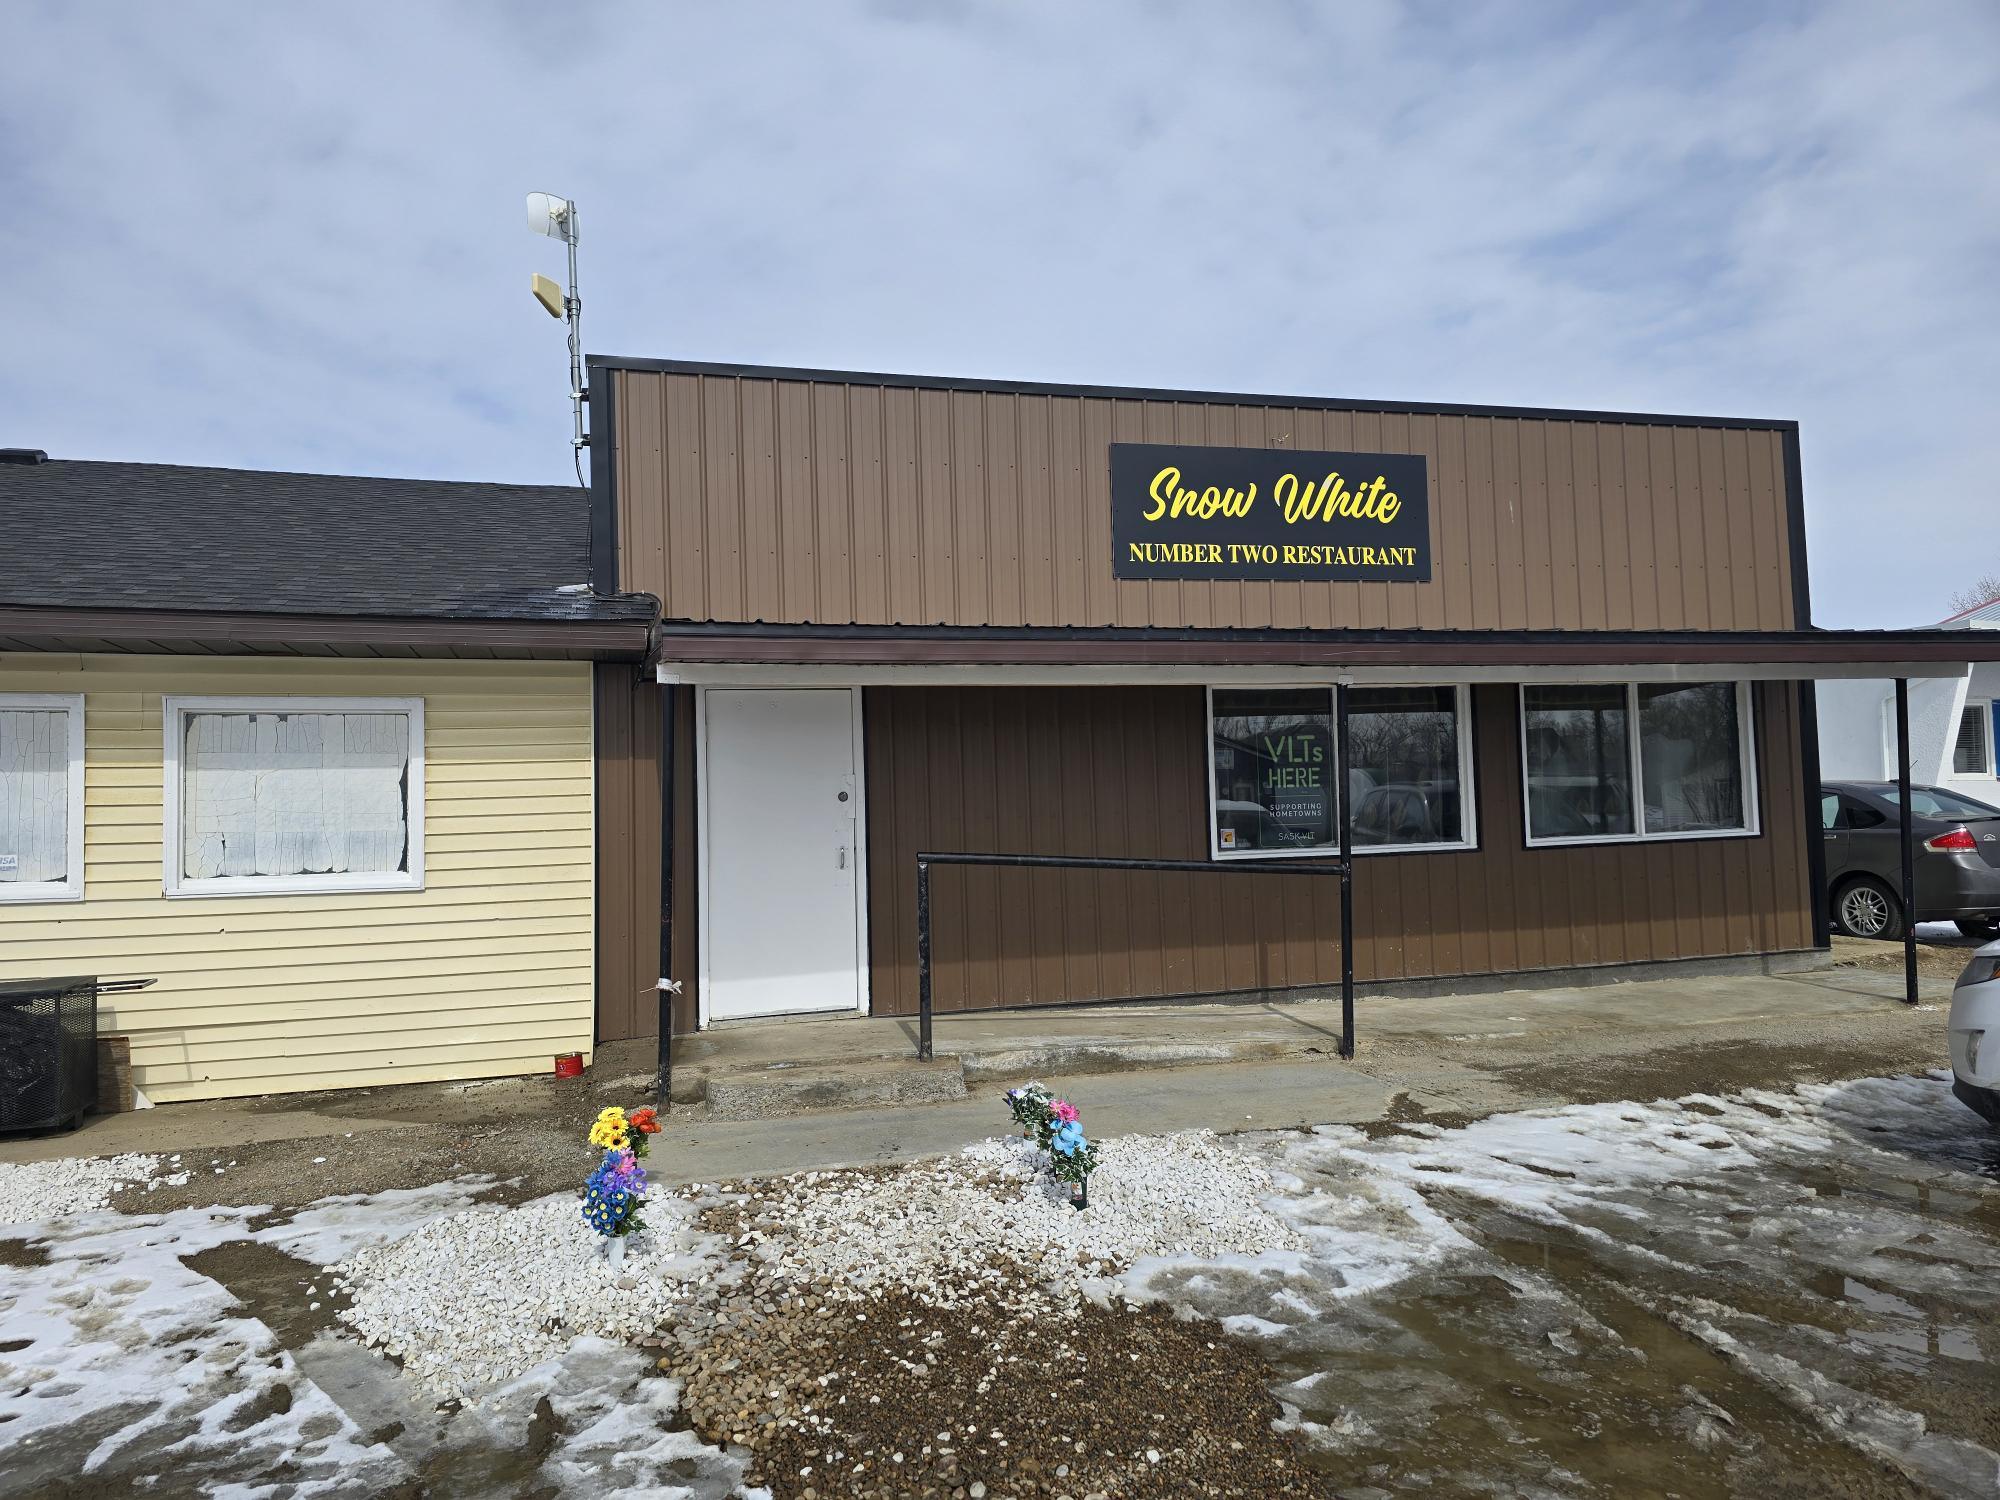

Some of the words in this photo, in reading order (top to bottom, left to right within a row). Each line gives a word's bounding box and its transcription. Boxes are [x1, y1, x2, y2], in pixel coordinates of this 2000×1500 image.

[1143, 466, 1257, 521] Snow
[1274, 471, 1401, 524] White
[1129, 542, 1223, 564] NUMBER
[1227, 544, 1278, 564] TWO
[1283, 545, 1416, 566] RESTAURANT
[1264, 735, 1323, 763] VLTs
[1268, 767, 1321, 788] HERE
[1270, 803, 1322, 811] SUPPORTING
